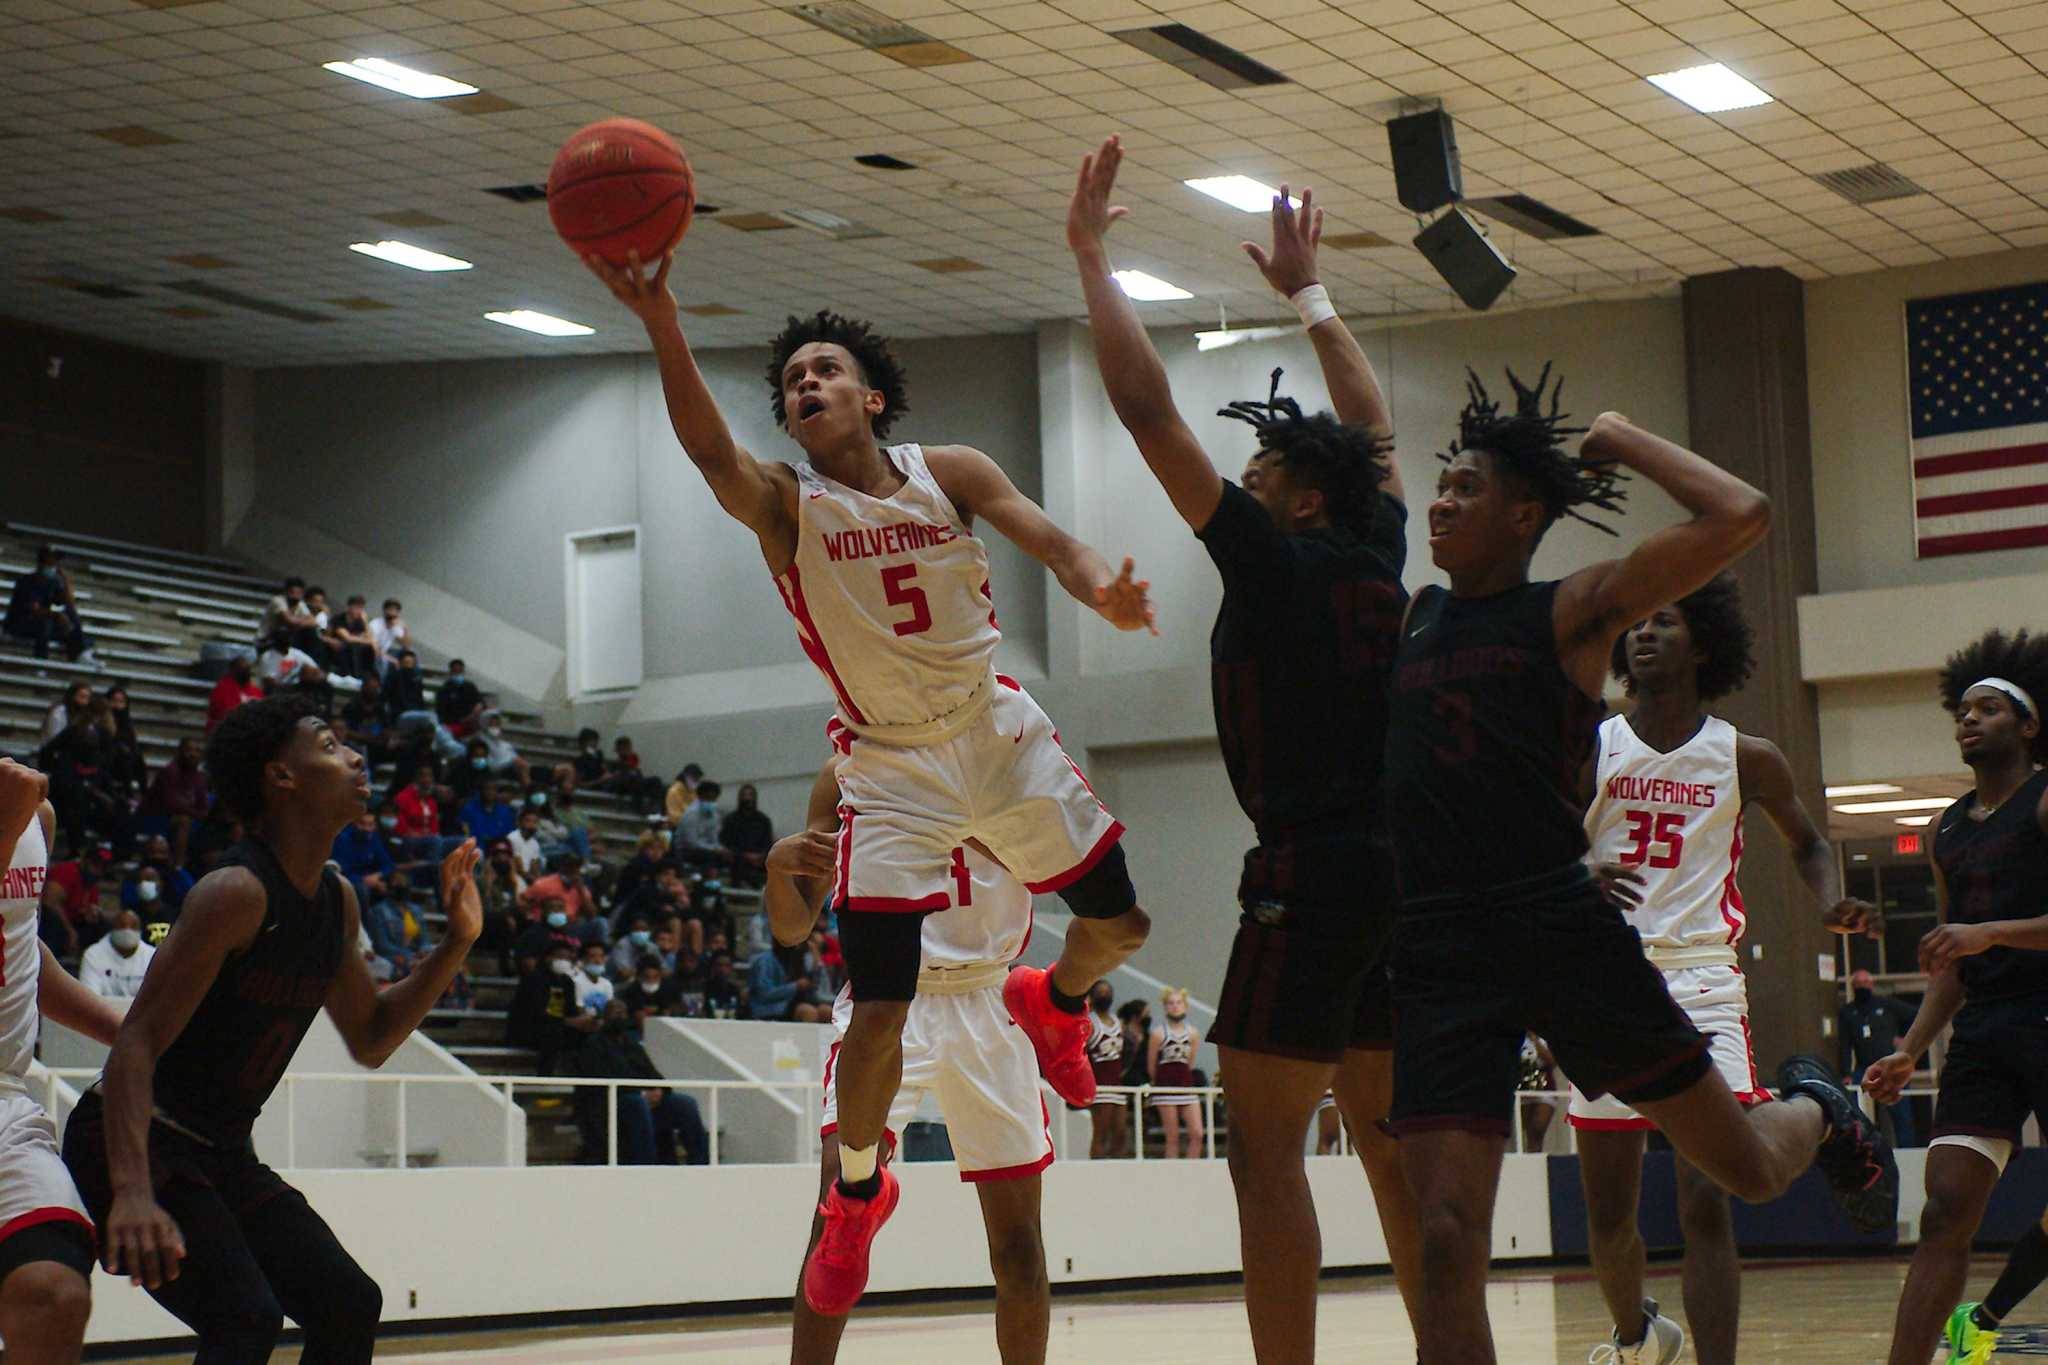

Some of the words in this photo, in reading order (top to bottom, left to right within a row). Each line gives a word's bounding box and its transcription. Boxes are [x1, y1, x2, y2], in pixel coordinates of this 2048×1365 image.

[880, 563, 932, 636] 5
[1607, 776, 1716, 808] WOLVERINES
[1619, 810, 1686, 869] 35
